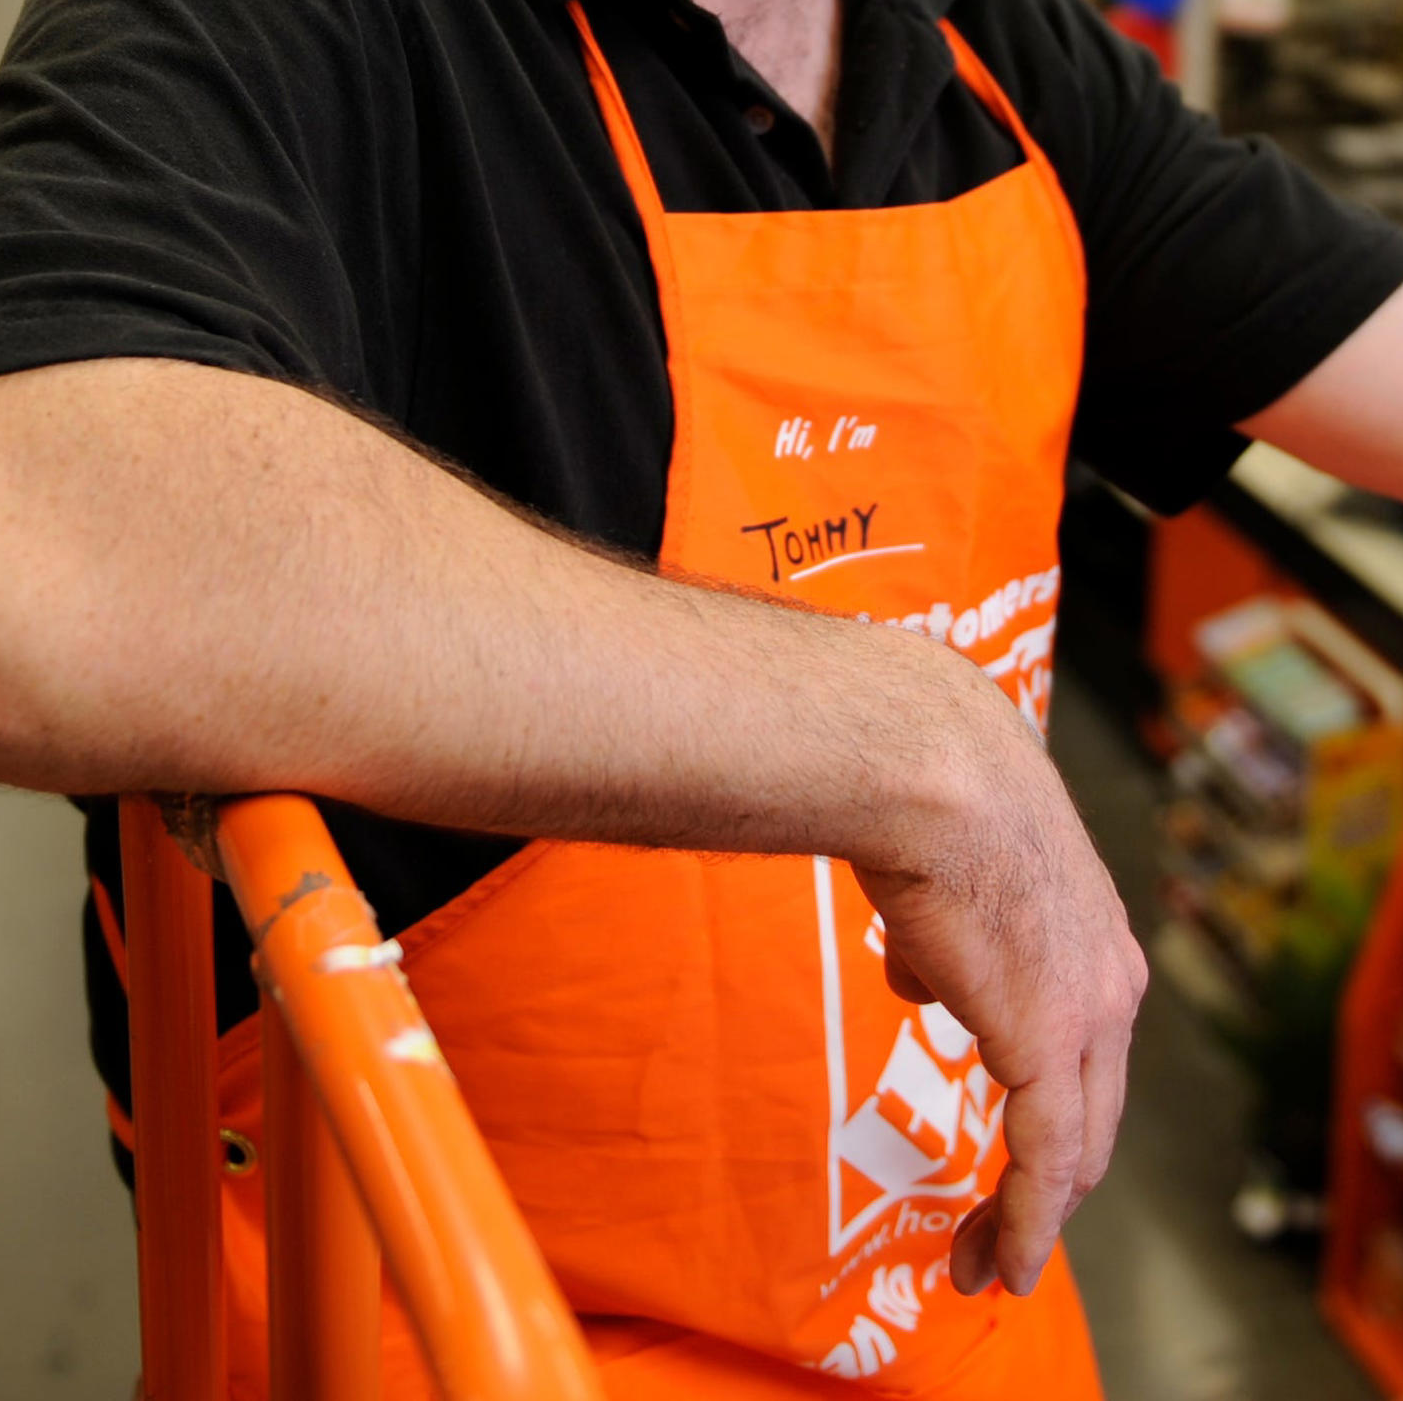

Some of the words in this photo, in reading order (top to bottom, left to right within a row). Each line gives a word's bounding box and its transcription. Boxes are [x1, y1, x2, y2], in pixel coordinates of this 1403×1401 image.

[774, 416, 814, 461] Hi,
[827, 415, 878, 453] I'm
[740, 502, 879, 583] TOMMY
